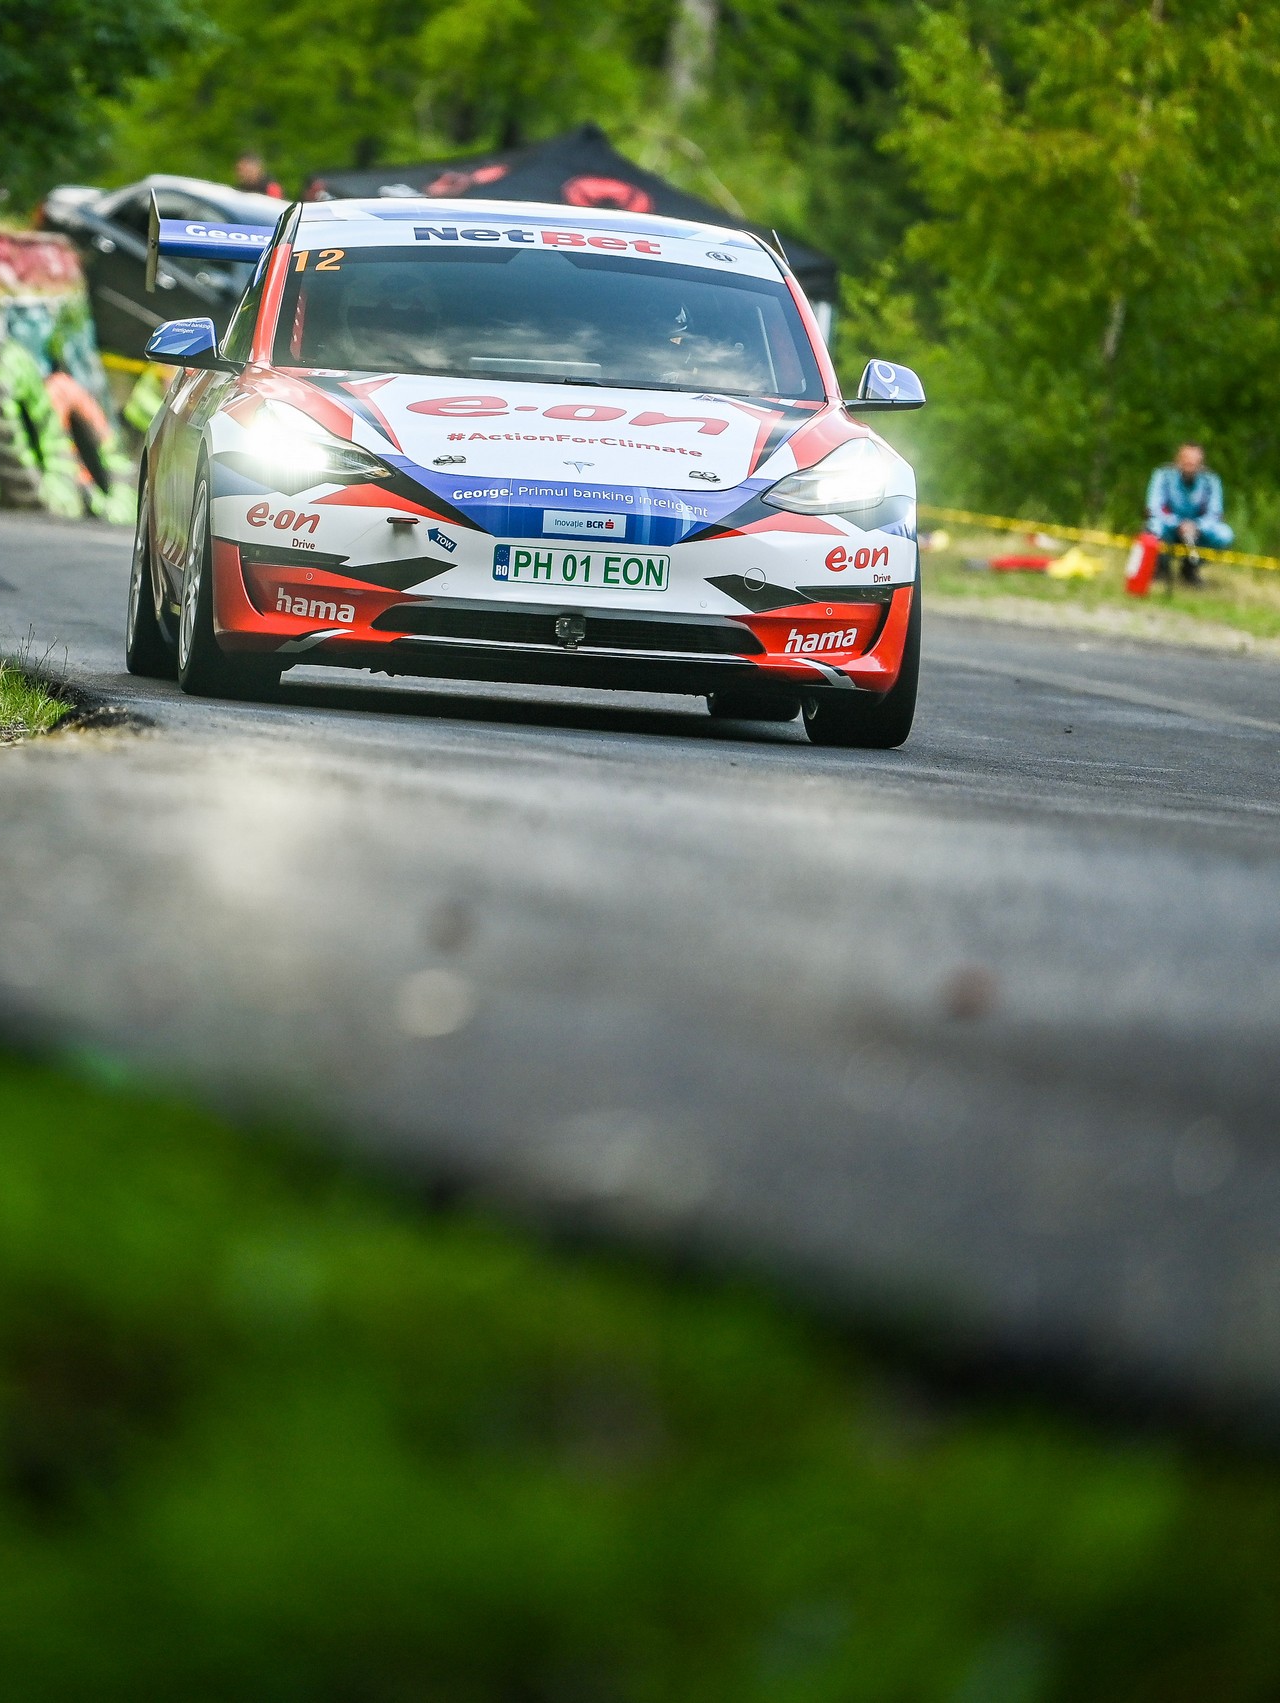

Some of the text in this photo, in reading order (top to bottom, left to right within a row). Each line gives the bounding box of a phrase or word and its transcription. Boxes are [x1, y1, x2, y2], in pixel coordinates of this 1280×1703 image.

[413, 227, 661, 254] NetBet
[293, 249, 345, 272] 12
[446, 432, 703, 458] #ActionForClimate
[453, 486, 708, 517] George. Primul banking inteligent
[586, 520, 604, 529] BCR
[292, 537, 316, 550] Drive
[436, 533, 454, 549] TOW
[495, 564, 508, 576] RO
[513, 550, 664, 586] PH 01 EON
[873, 573, 891, 583] Drive
[276, 587, 356, 623] hama
[784, 627, 858, 653] hama
